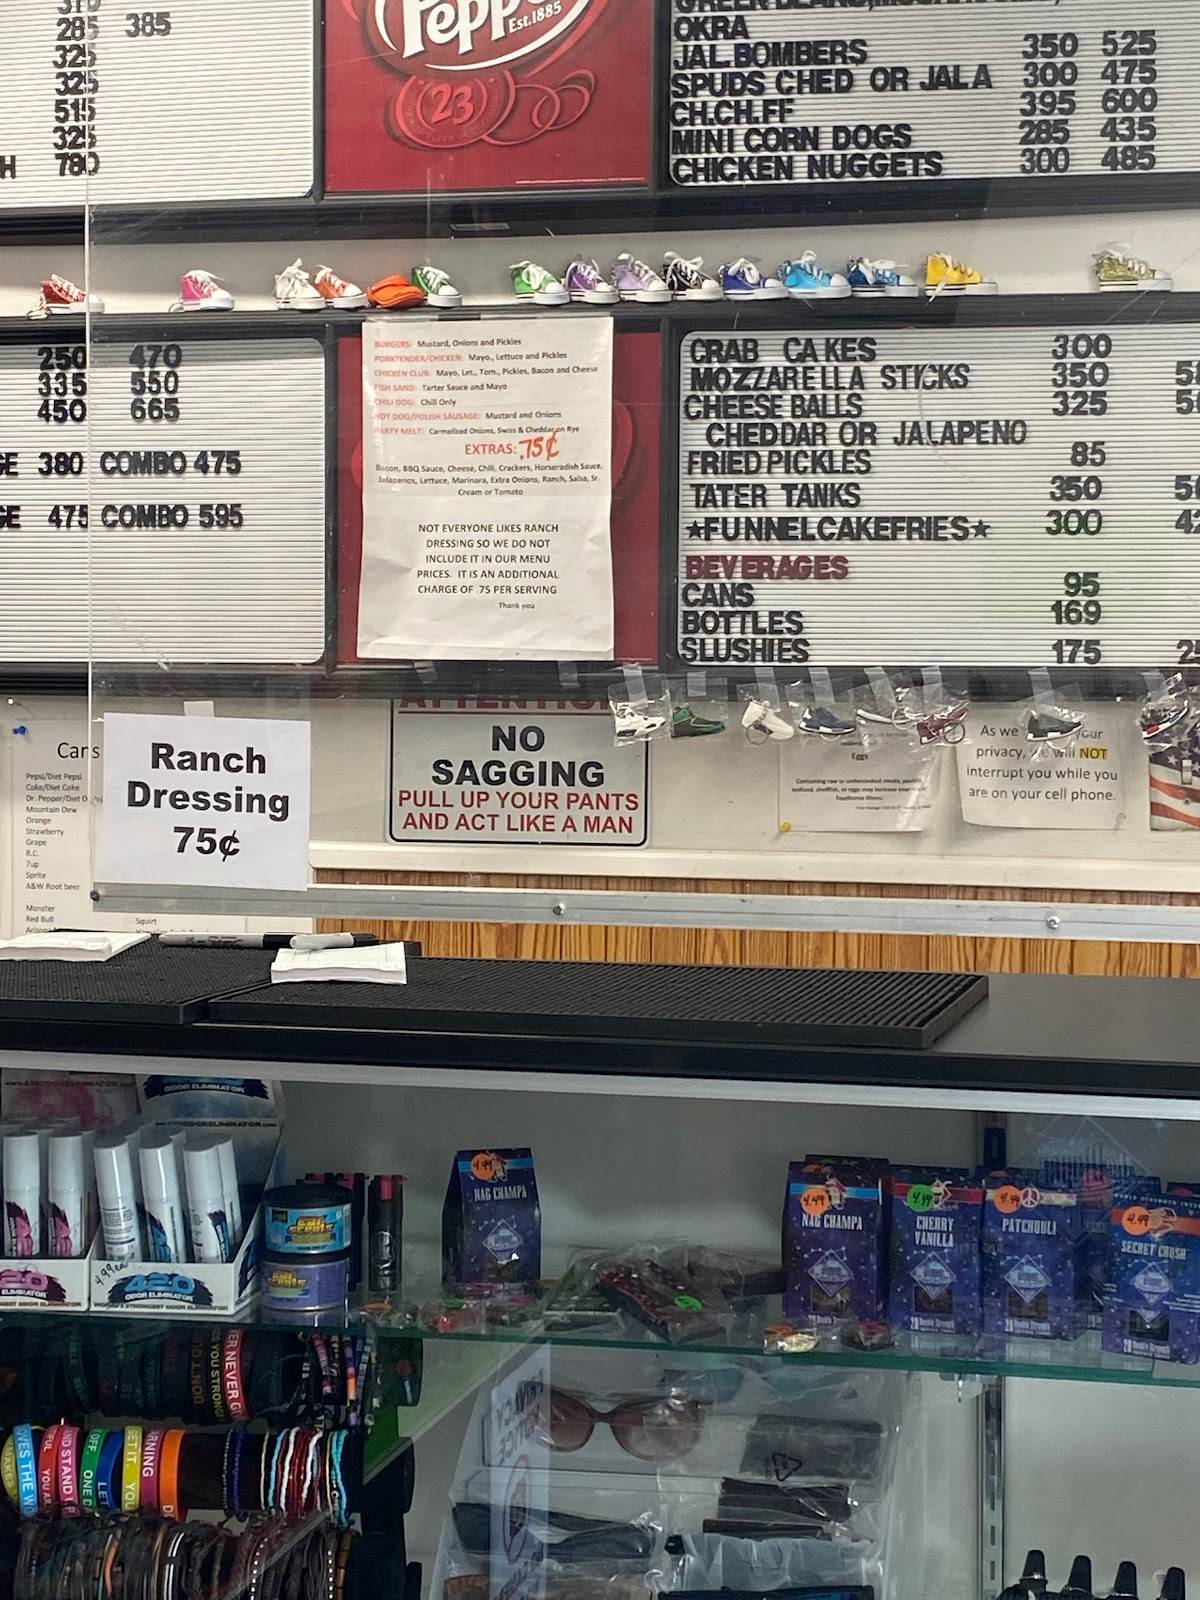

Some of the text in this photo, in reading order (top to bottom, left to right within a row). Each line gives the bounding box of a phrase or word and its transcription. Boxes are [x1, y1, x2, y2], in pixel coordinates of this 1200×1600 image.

[56, 12, 171, 41] 285 385
[673, 15, 749, 42] OKRA
[53, 44, 97, 68] 325
[733, 38, 868, 68] BOMBERS
[1022, 32, 1079, 59] 350
[1102, 29, 1157, 57] 525
[55, 70, 99, 95] 325
[671, 59, 1157, 99] SPUDS CHED OR JALA 300 475
[55, 98, 97, 123] 515
[432, 84, 473, 124] 23
[1019, 90, 1076, 117] 395
[1101, 87, 1158, 114] 600
[53, 125, 97, 149] 325
[672, 116, 1156, 154] MINI CORN DOGS 285 435
[55, 152, 100, 176] 780
[672, 145, 1156, 183] CHICKEN NUGGETS 300 485
[37, 344, 182, 371] 250 470
[690, 333, 1112, 364] CRAB CAKES 300
[38, 370, 179, 397] 335 550
[690, 362, 1109, 392] MOZZARELLA STICKS 350
[37, 397, 180, 423] 450 665
[683, 390, 1107, 420] CHEESE BALLS 325
[705, 419, 1026, 448] CHEDDAR OR JALAPENO
[465, 443, 517, 455] EXTRAS:
[687, 441, 1106, 476] FRIED PICKLES 85
[38, 450, 242, 476] 380 COMBO 475
[690, 475, 1101, 509] TATER TANKS 350
[48, 504, 243, 529] 475 COMBO 595
[418, 524, 559, 533] NOT EVERYONE LIKES RANCH
[1046, 509, 1102, 535] 300
[426, 539, 550, 548] DRESSING SO WE DO NOT
[426, 555, 550, 564] INCLUDE IT IN OUR MENU
[685, 555, 849, 581] BEVERAGES
[417, 570, 559, 579] PRICES. IT IS AN ADDITIONAL
[418, 585, 457, 594] CHARGE
[460, 585, 473, 594] OF
[494, 585, 512, 594] PER
[514, 585, 557, 595] SERVING
[681, 572, 1100, 607] CANS 95
[681, 599, 1101, 635] BOTTLES 169
[681, 637, 1101, 665] SLUSHIES 175
[491, 725, 545, 752] NO
[980, 725, 1018, 737] As we
[151, 742, 266, 774] Ranch
[851, 752, 868, 761] Eggs
[976, 747, 1108, 761] privacy, will NOT
[431, 759, 605, 787] SAGGING
[967, 766, 1118, 783] interrupt you while you
[127, 780, 289, 822] Dressing
[398, 790, 639, 811] PULL UP YOUR PANTS
[969, 787, 1116, 802] are on your cell phone.
[25, 816, 51, 825] Orange
[25, 828, 64, 836] Strawberry
[403, 812, 633, 833] AND ACT LIKE A MAN
[25, 839, 47, 847] Grape
[173, 826, 240, 862] 75¢
[25, 872, 46, 880] Sprite
[474, 1185, 527, 1201] NAG CHAMPA
[802, 1213, 863, 1230] NAG CHAMPA
[916, 1216, 954, 1232] CHERRY
[1002, 1218, 1056, 1235] PATCHOULI
[915, 1231, 954, 1248] VANILLA
[1121, 1240, 1156, 1256] SECRET
[125, 1291, 194, 1302] ODOR ELIMINATOR
[224, 1351, 240, 1400] NEVER
[20, 1463, 35, 1493] THE
[61, 1450, 72, 1495] STAND
